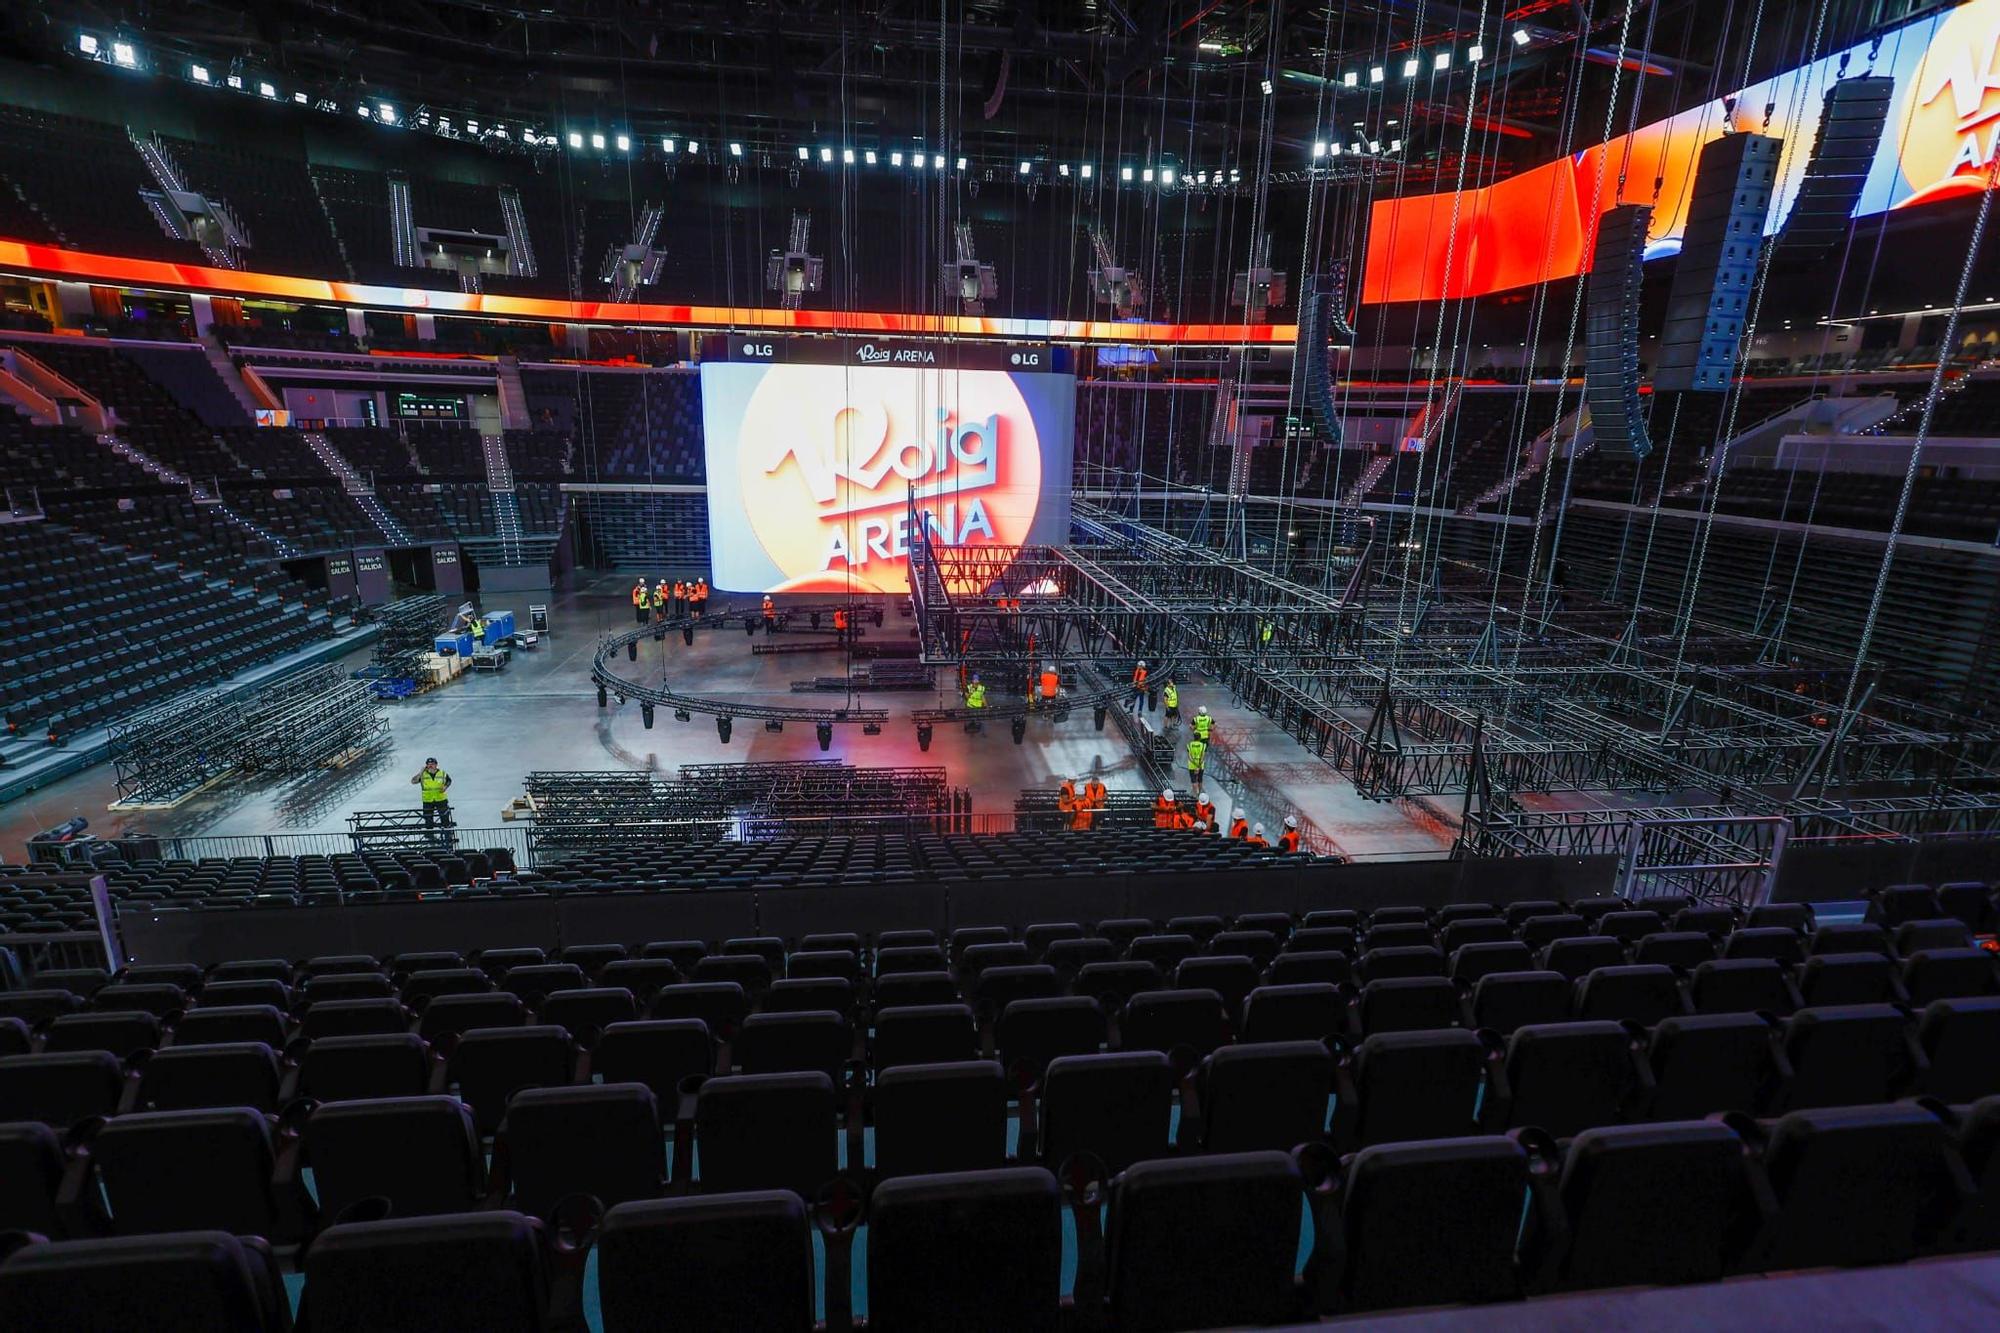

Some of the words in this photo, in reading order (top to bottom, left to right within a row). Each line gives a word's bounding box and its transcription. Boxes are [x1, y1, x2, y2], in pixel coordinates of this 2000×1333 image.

[755, 344, 773, 356] LG
[856, 344, 890, 363] Roig
[894, 349, 935, 363] ARENA
[1022, 353, 1039, 365] LG
[766, 393, 998, 516] Roig
[819, 497, 993, 572] ARENA
